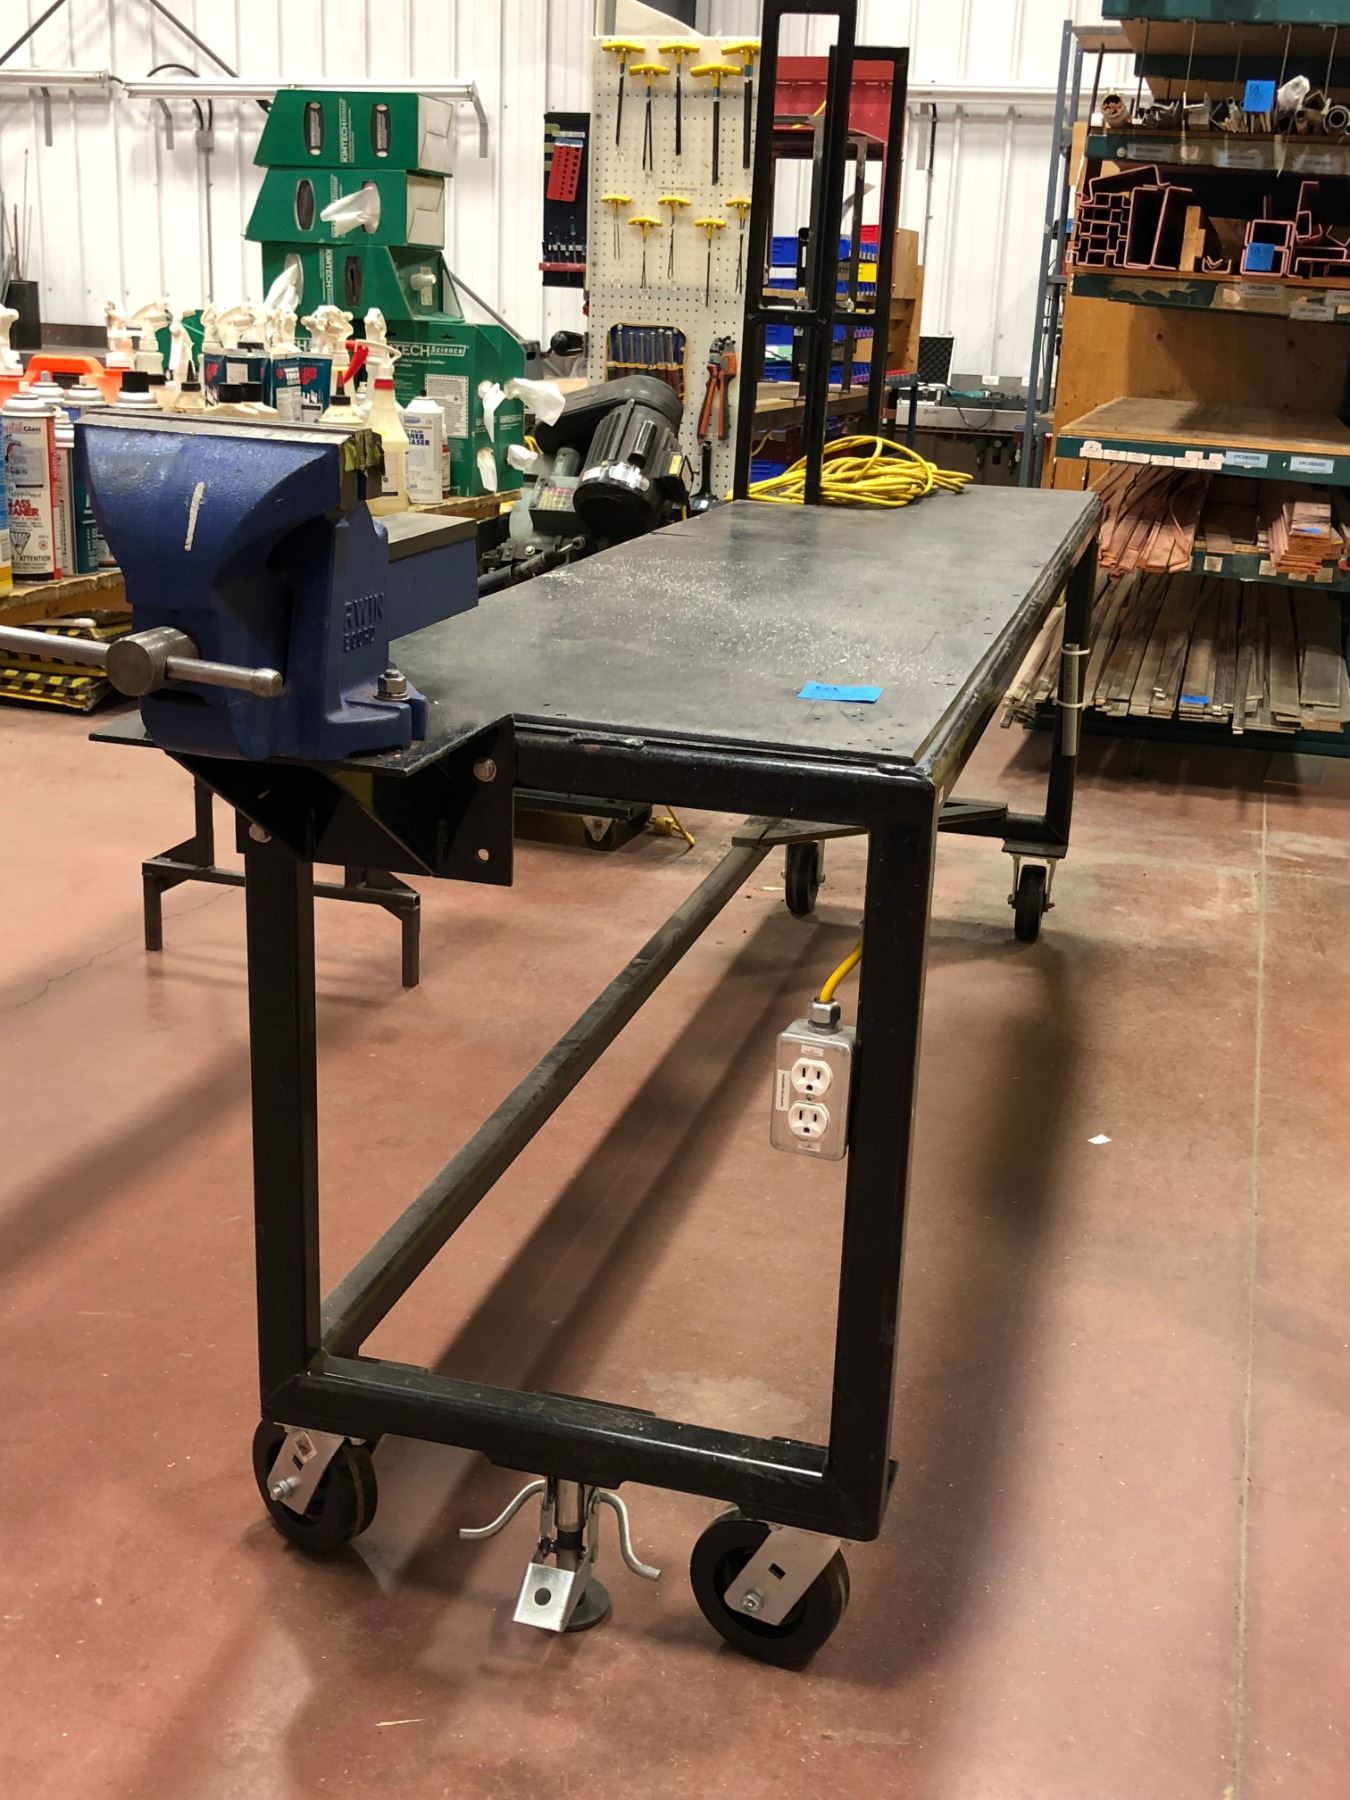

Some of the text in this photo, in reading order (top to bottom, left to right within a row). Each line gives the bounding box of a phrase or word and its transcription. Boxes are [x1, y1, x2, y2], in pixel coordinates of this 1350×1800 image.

[340, 122, 348, 163] KIMTECH
[325, 248, 333, 288] KIMTECH
[394, 344, 464, 357] TECH Science
[8, 498, 31, 508] LASS
[8, 507, 39, 517] EANER
[343, 592, 385, 632] RWIN
